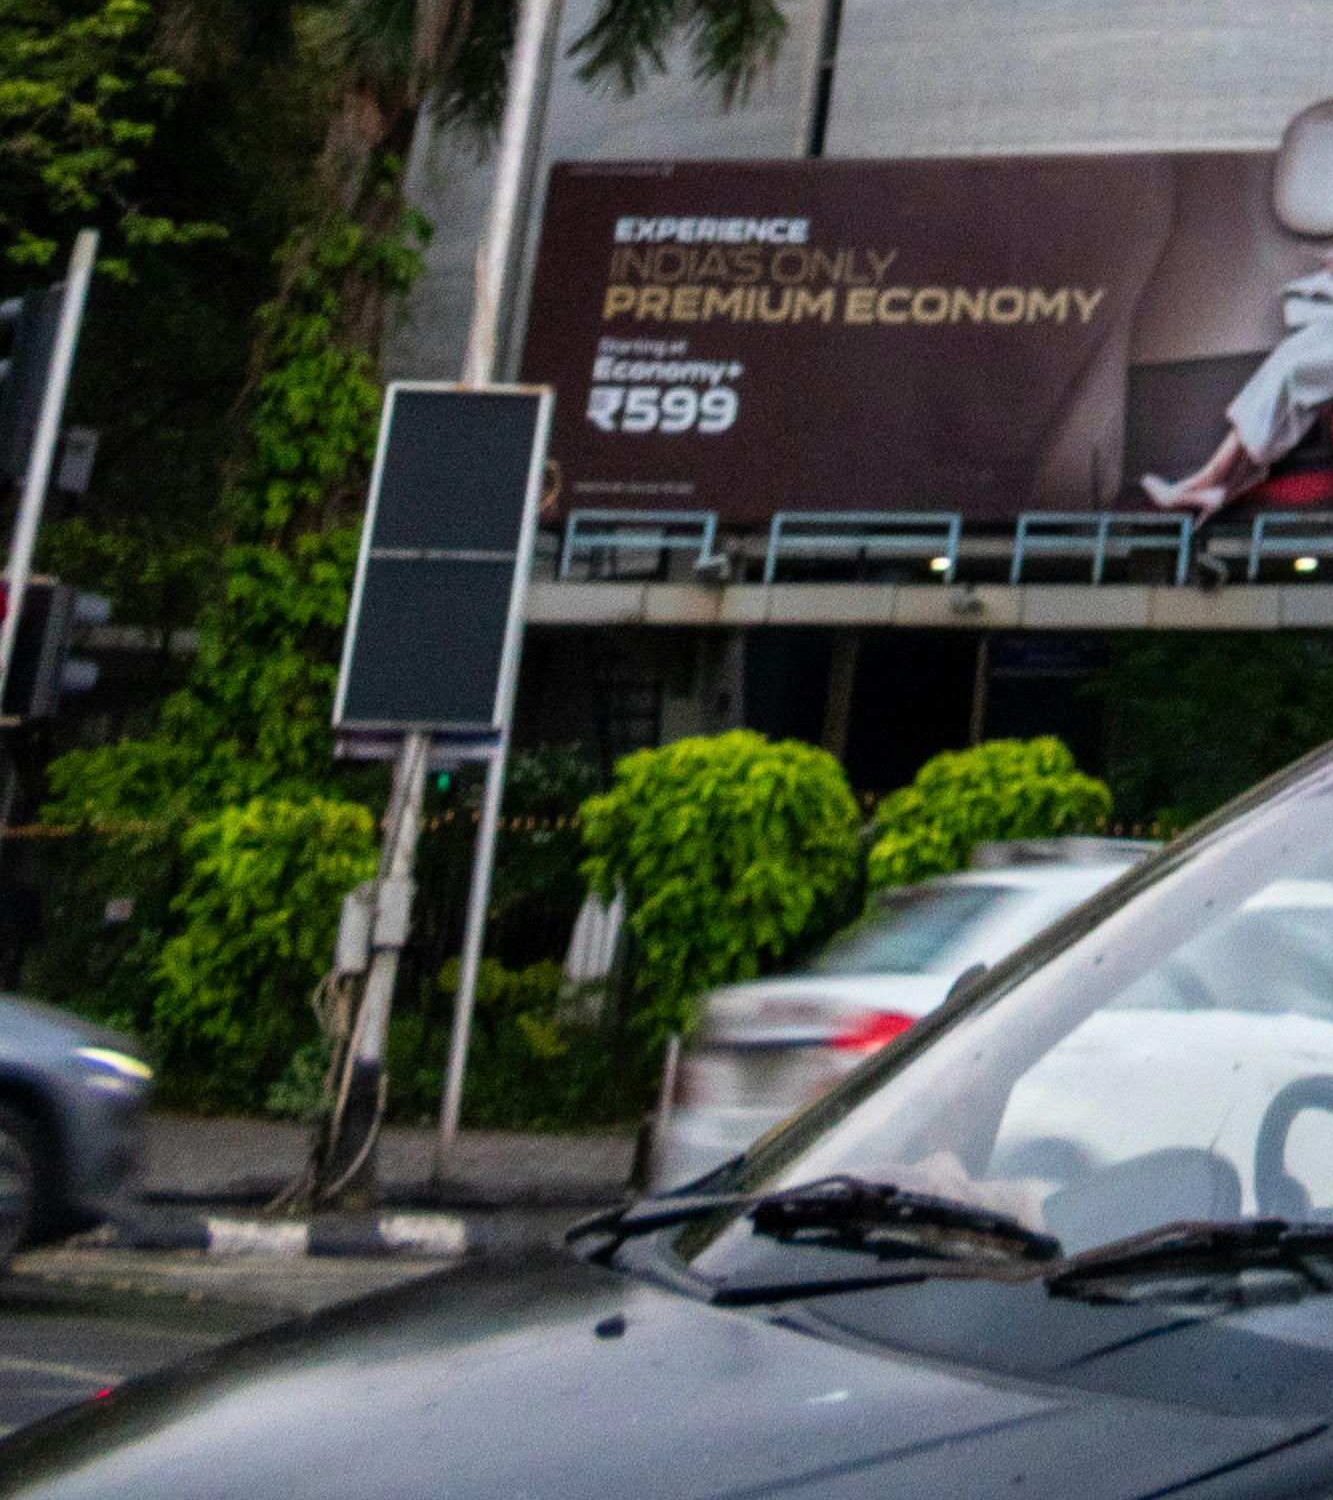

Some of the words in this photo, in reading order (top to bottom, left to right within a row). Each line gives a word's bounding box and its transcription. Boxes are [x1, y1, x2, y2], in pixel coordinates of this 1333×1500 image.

[613, 216, 811, 244] EXPERIENCE
[769, 248, 899, 286] ONLY
[602, 285, 835, 323] PREMIUM
[844, 287, 1104, 325] ECONOMY
